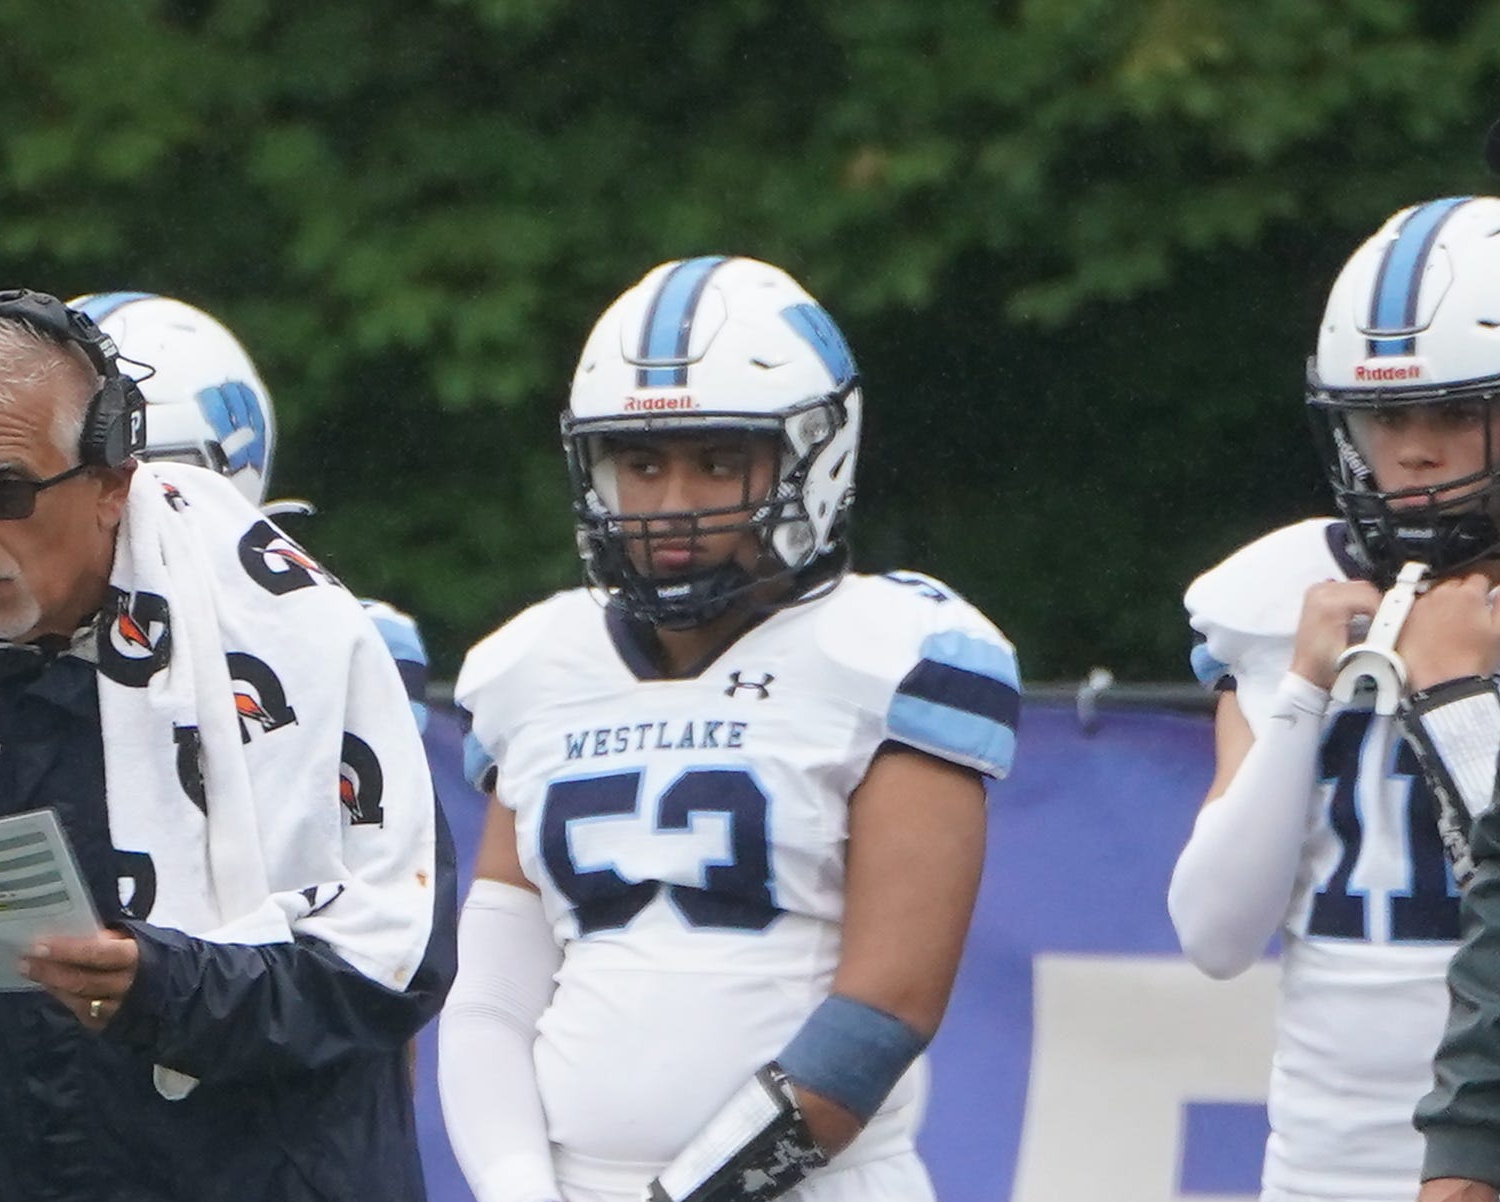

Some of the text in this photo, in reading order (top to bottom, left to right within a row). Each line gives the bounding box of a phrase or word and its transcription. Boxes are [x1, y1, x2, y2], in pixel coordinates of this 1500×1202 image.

[1356, 366, 1421, 382] Riddell
[624, 396, 692, 411] Riddell
[564, 720, 748, 760] WESTLAKE
[1302, 708, 1466, 943] 11
[537, 763, 790, 938] 53
